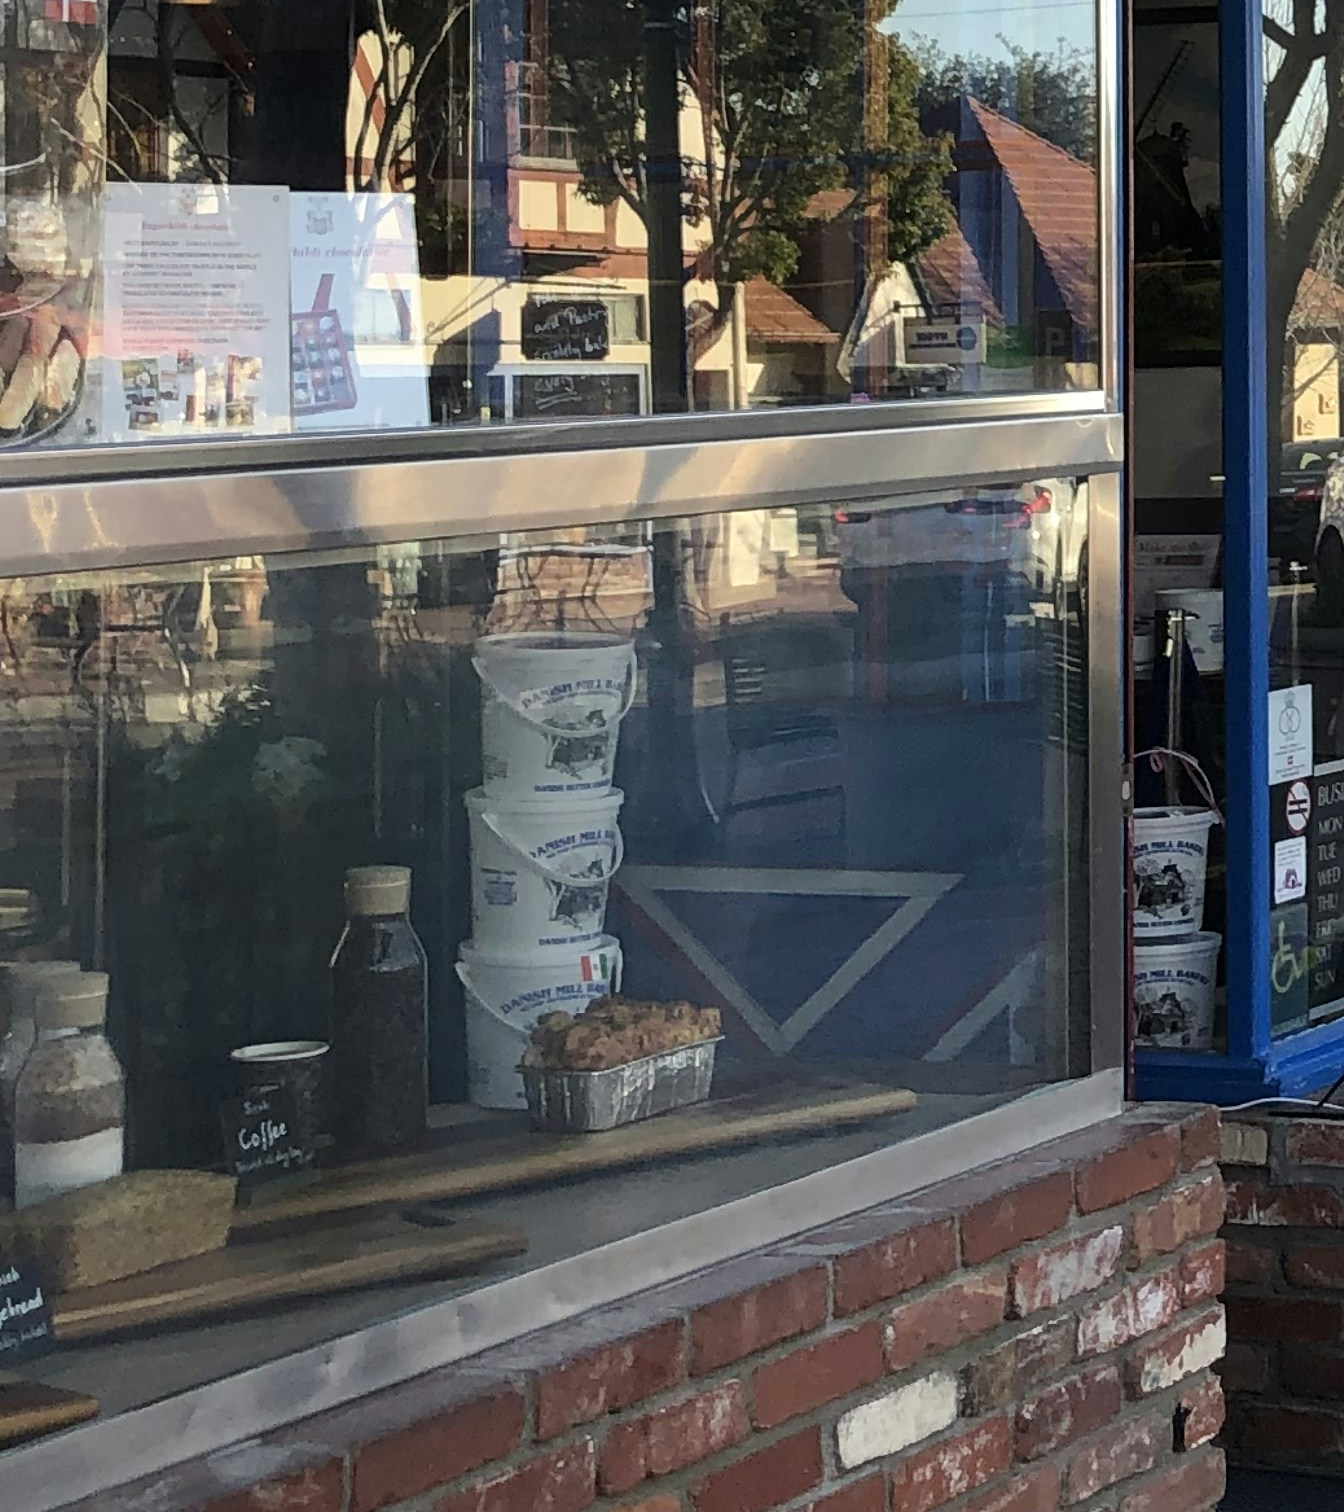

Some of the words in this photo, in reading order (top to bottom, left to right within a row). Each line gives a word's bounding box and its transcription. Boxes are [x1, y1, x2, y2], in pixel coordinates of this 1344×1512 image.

[1318, 816, 1343, 835] MON
[1318, 842, 1337, 861] TUE
[1317, 866, 1341, 886] WED
[1317, 893, 1339, 913] THU
[1315, 968, 1337, 986] SUN
[238, 1119, 288, 1151] Coffee
